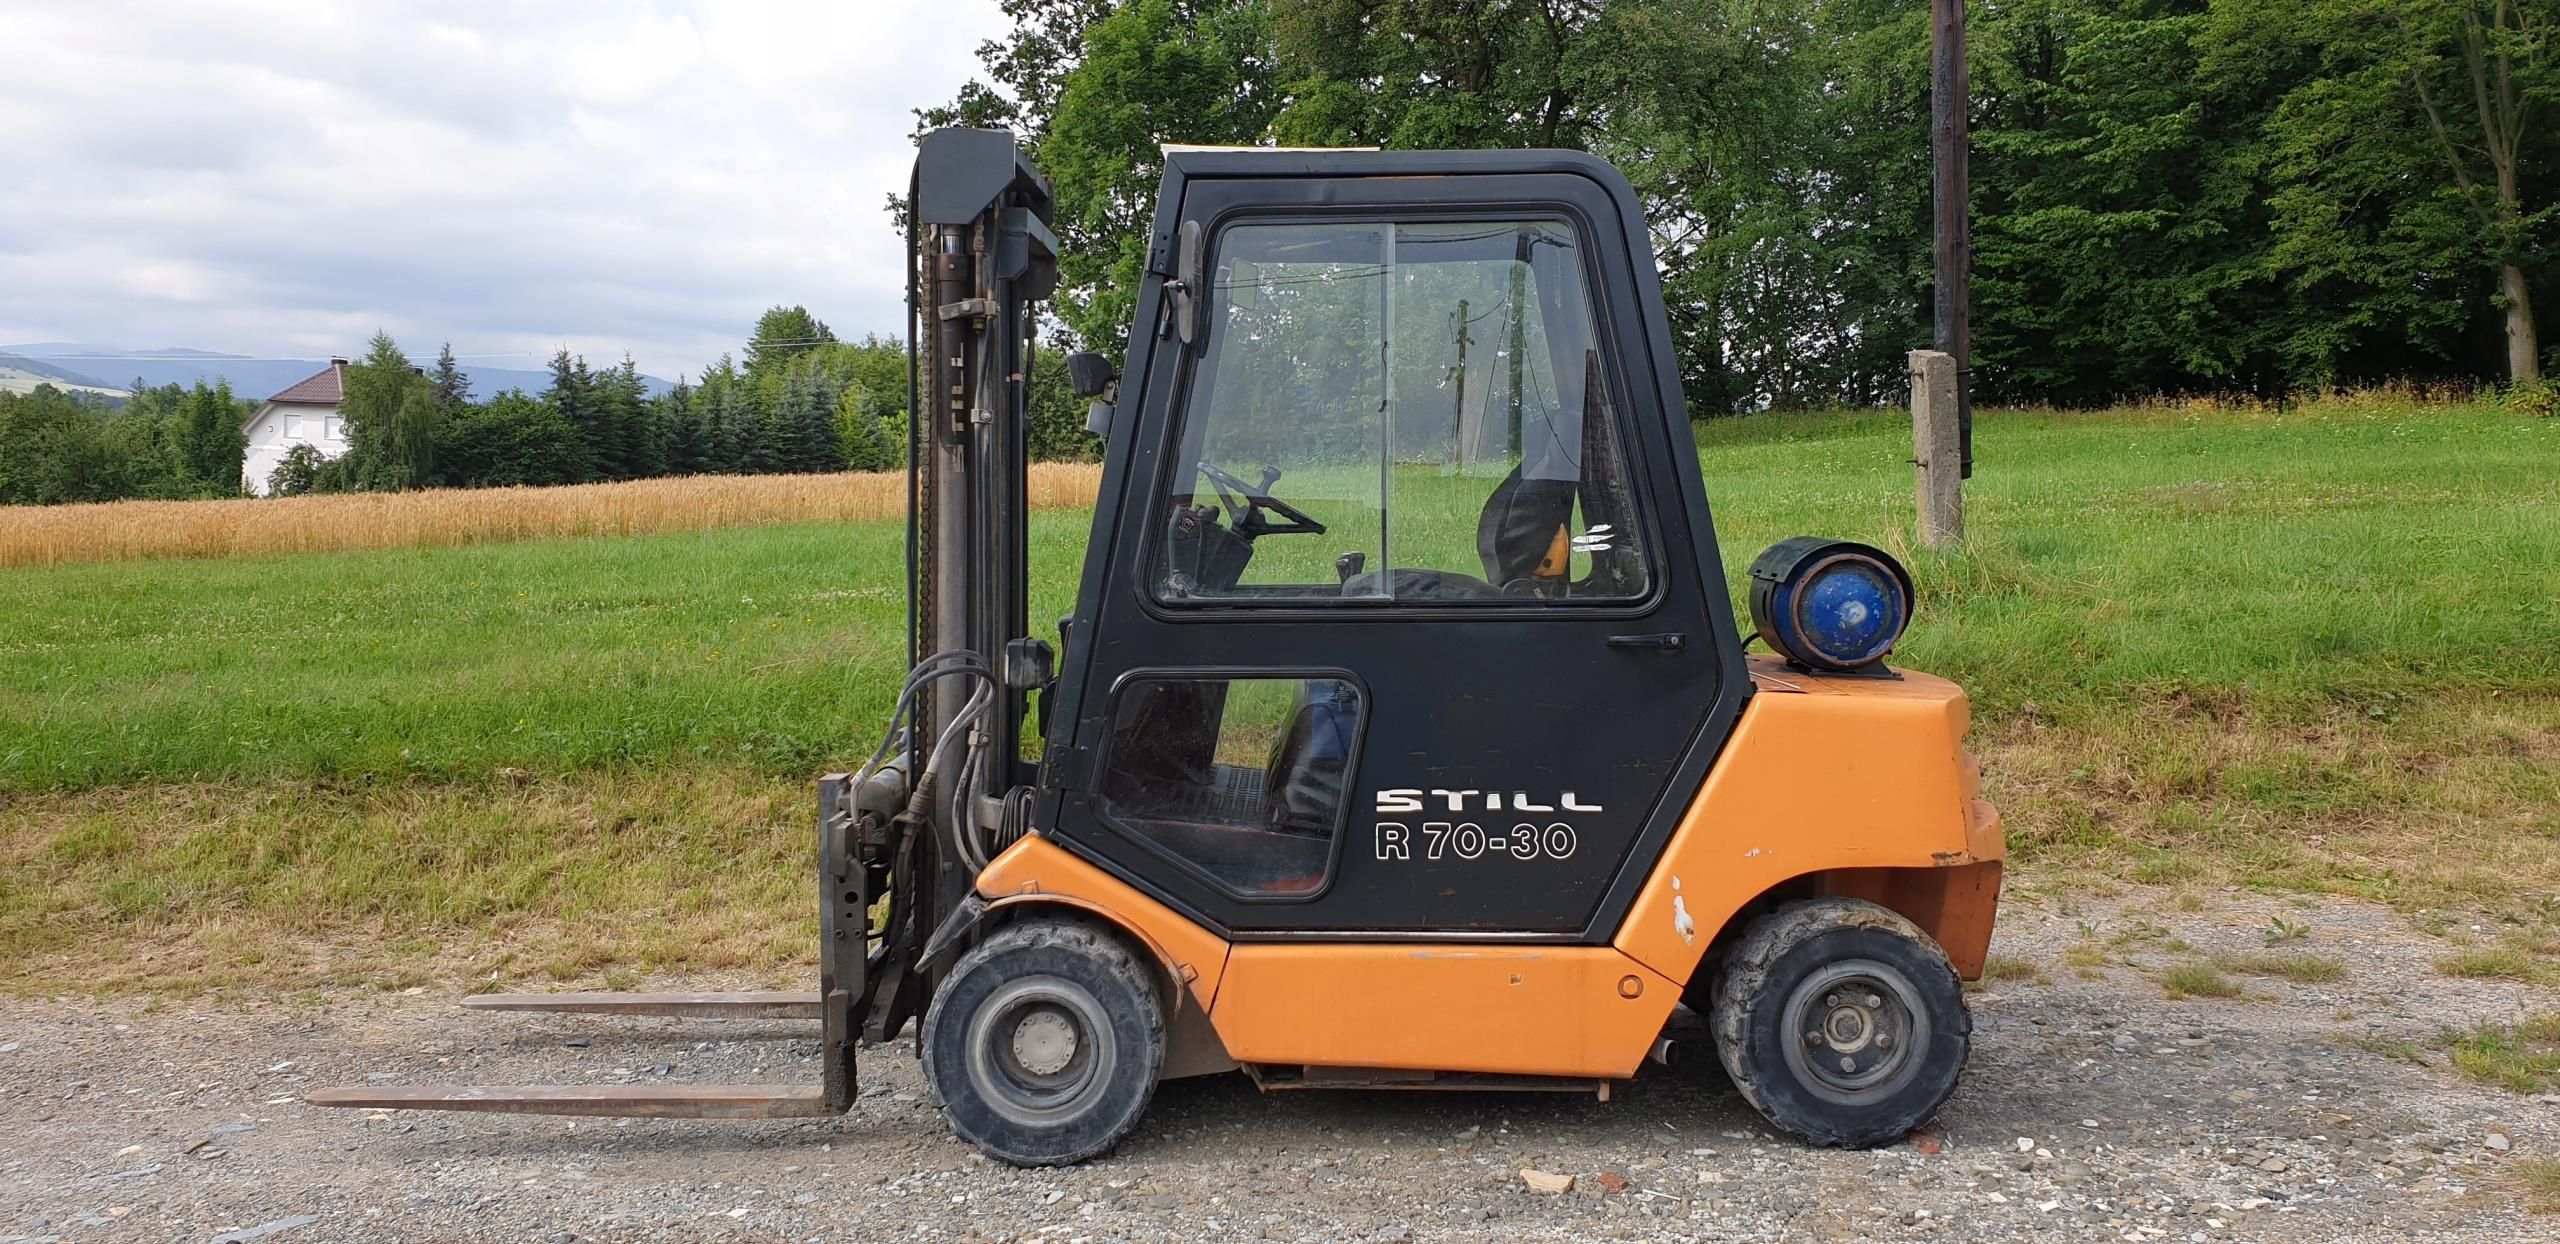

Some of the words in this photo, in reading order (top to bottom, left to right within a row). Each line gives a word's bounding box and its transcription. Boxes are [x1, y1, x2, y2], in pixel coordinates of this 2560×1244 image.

[951, 342, 965, 472] STILL
[1376, 789, 1603, 811] STILL
[1376, 822, 1409, 860] R
[1423, 822, 1576, 860] 70-30
